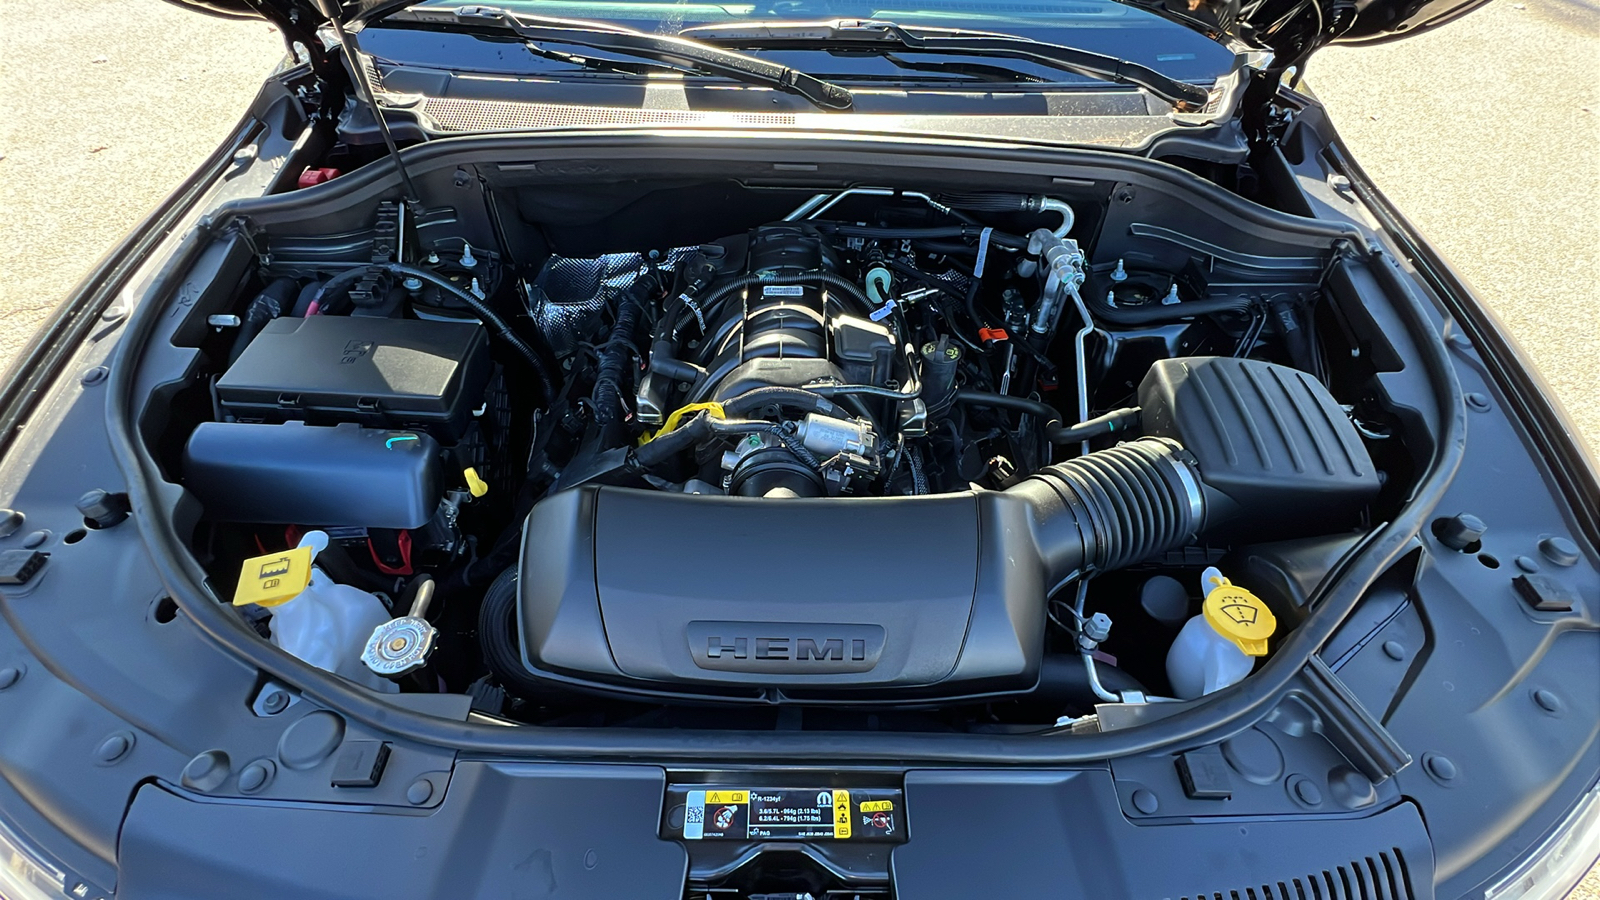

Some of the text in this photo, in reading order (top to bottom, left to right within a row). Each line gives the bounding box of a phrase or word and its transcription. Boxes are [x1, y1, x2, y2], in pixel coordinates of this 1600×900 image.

[383, 659, 407, 670] OPEN
[408, 646, 423, 661] HOT
[707, 637, 865, 661] HEMI
